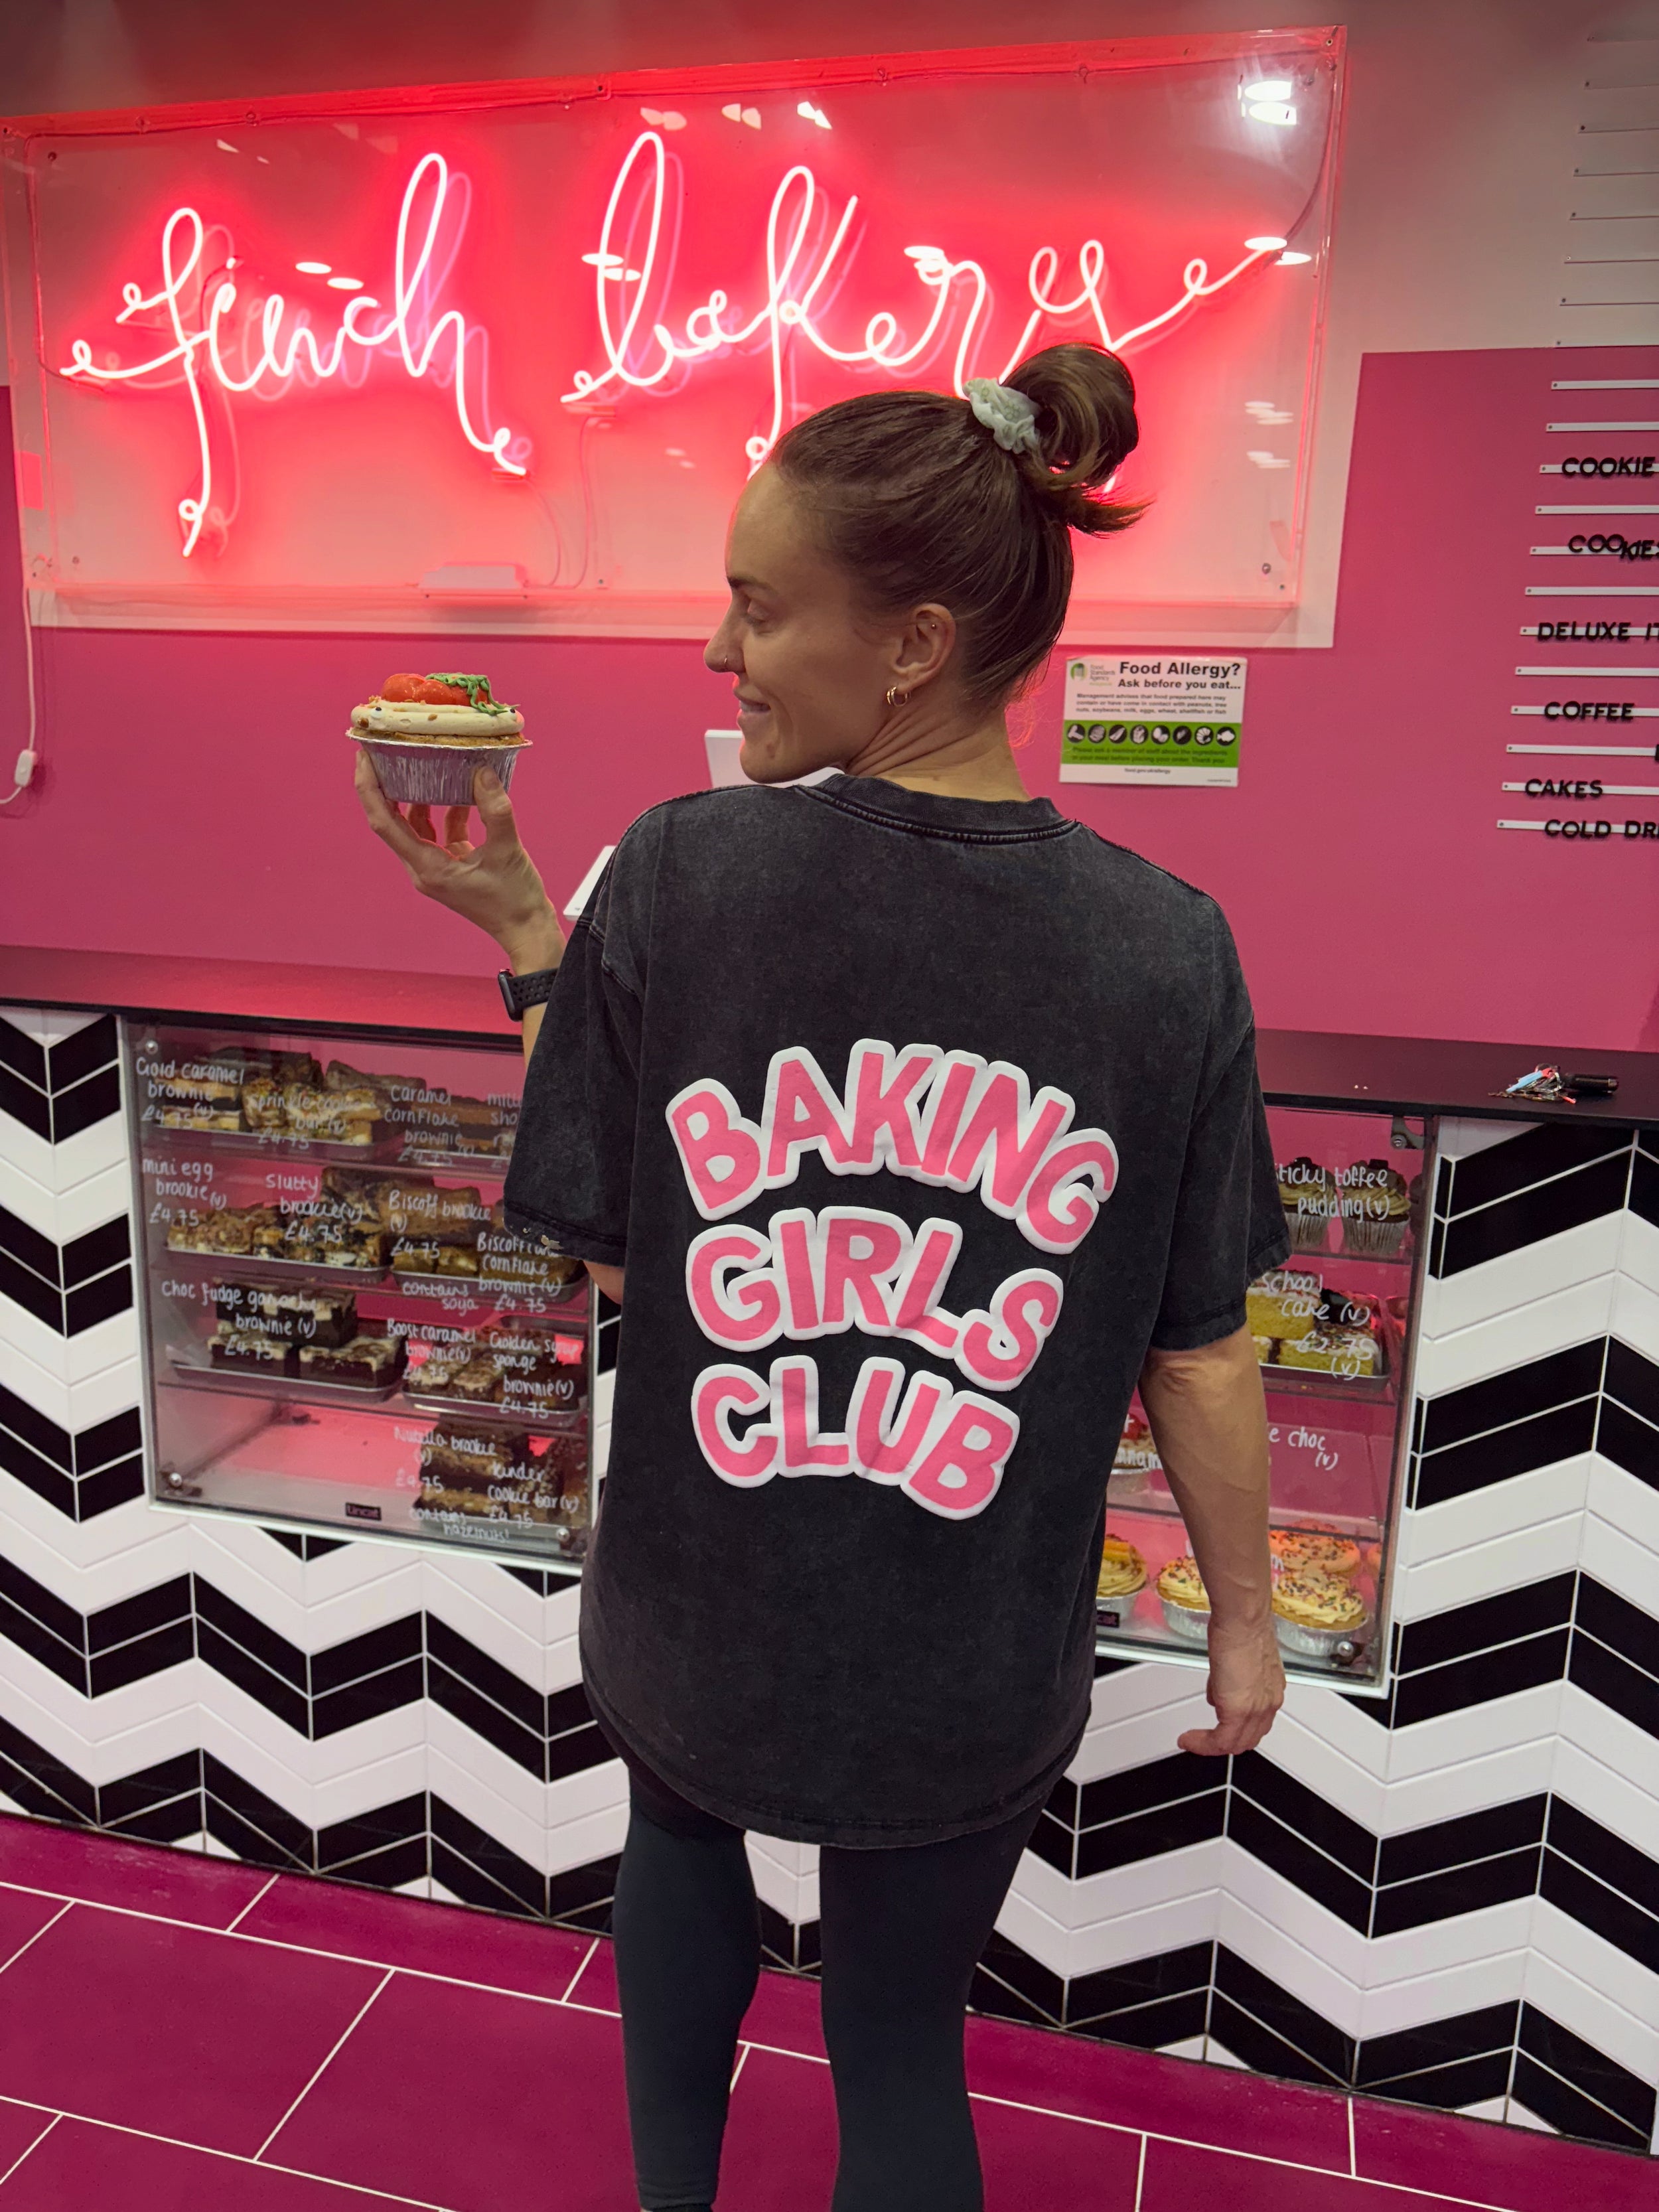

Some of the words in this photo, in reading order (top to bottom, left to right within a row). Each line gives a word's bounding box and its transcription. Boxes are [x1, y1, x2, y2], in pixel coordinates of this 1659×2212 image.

[61, 207, 527, 557] finch
[1562, 457, 1655, 477] COOKIE
[1568, 534, 1659, 560] COOKIE
[1538, 622, 1630, 640] DELUXE
[1119, 661, 1161, 674] Food
[1167, 662, 1240, 678] Allergy?
[1118, 678, 1139, 688] Ask
[1144, 678, 1181, 688] before
[1186, 681, 1206, 690] you
[1210, 681, 1240, 690] eat...
[1545, 701, 1634, 720] COFFEE
[1525, 779, 1603, 797] CAKES
[1544, 820, 1611, 838] COLD
[1624, 820, 1659, 838] DR
[181, 1063, 244, 1084] caramel
[666, 1039, 1119, 1254] BAKING
[143, 1157, 177, 1175] mini
[181, 1163, 213, 1182] egg
[1275, 1163, 1326, 1193] ticky
[1334, 1166, 1388, 1189] toffee
[156, 1179, 208, 1201] brookie
[149, 1203, 199, 1226] £4.75
[389, 1189, 438, 1218] Biscoff
[284, 1222, 342, 1244] £4.75
[202, 1282, 244, 1311] fudge
[441, 1297, 479, 1317] soya
[686, 1207, 1063, 1391] GIRLS
[1281, 1297, 1329, 1320] cake
[1340, 1301, 1371, 1326] (v)
[236, 1312, 293, 1335] brownie
[298, 1317, 317, 1339] (v)
[420, 1325, 476, 1344] caramel
[492, 1353, 536, 1375] sponge
[1331, 1356, 1360, 1381] (v)
[498, 1396, 549, 1420] £4.75
[691, 1355, 1020, 1519] CLUB
[1288, 1426, 1326, 1451] choc
[1315, 1451, 1338, 1471] (v)
